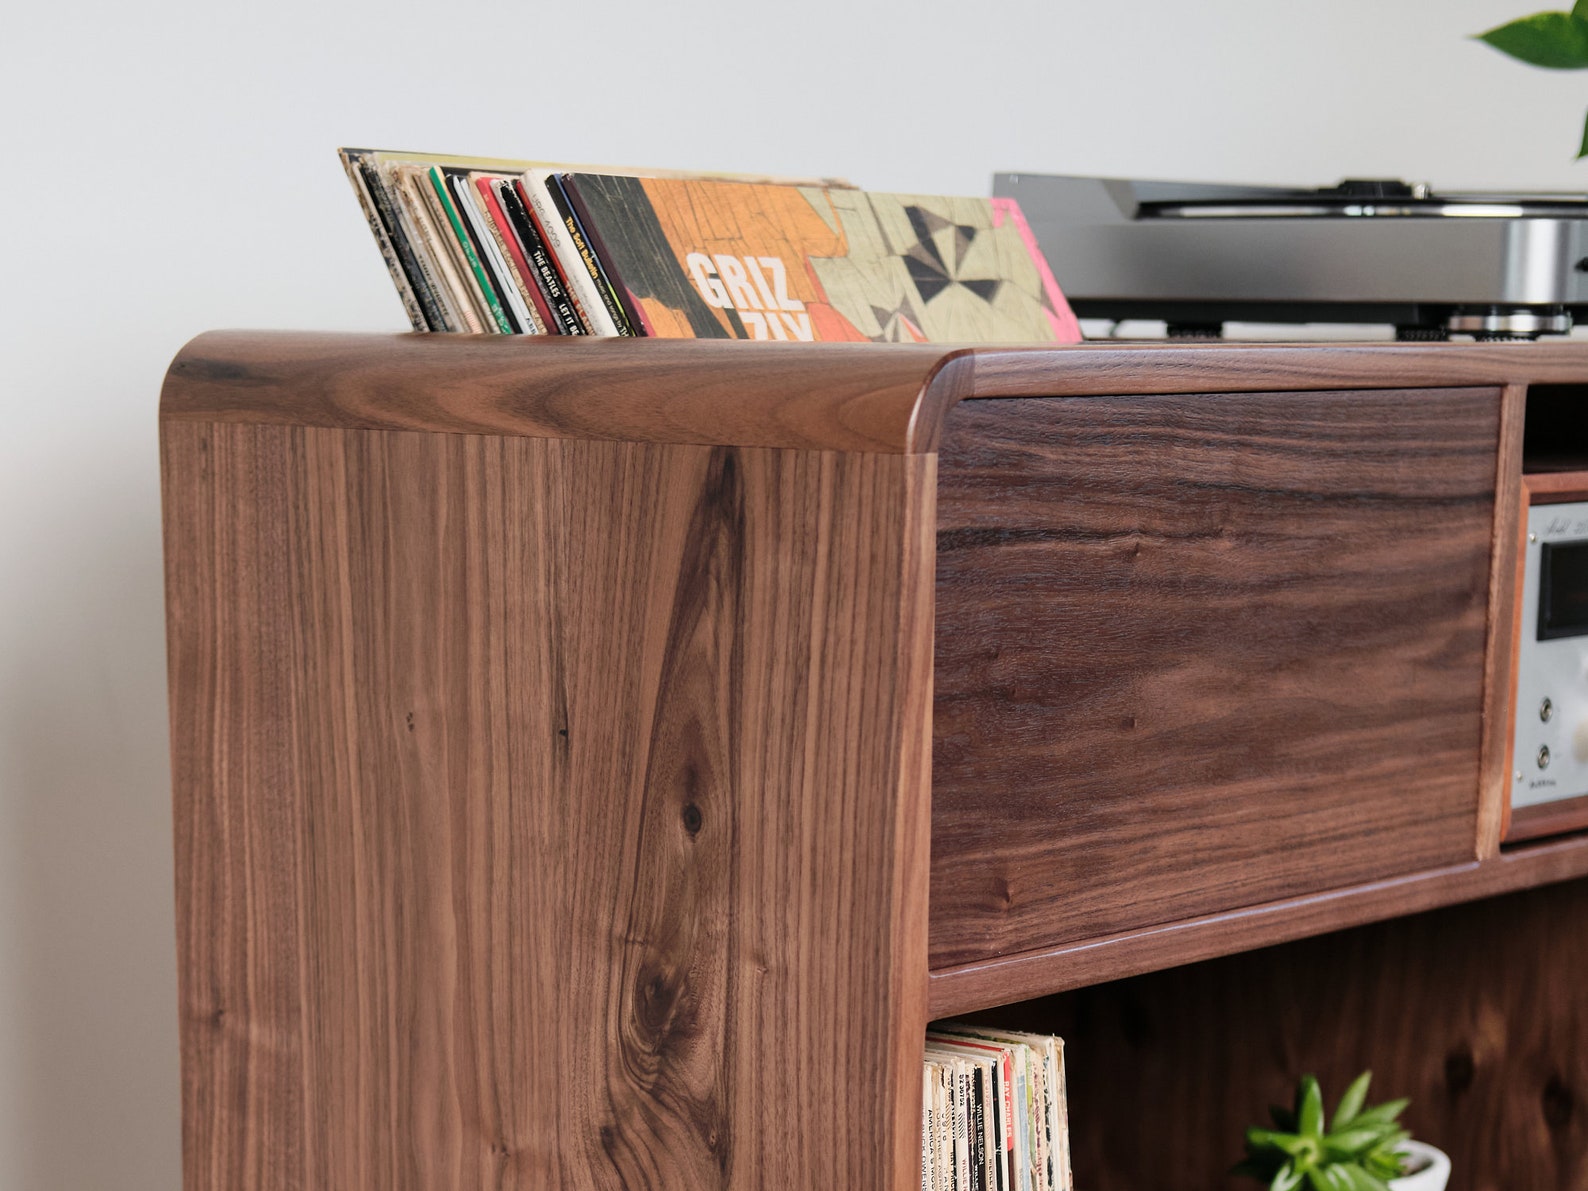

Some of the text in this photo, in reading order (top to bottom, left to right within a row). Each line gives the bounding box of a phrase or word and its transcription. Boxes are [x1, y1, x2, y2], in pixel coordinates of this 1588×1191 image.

[566, 217, 576, 234] The
[573, 233, 585, 251] Soft
[581, 249, 599, 280] Bulletin
[533, 251, 545, 268] THE
[541, 264, 561, 298] BEATLES
[559, 303, 568, 318] LET
[565, 314, 574, 326] IT
[686, 252, 806, 312] GRIZ
[1003, 1080, 1012, 1138] RAY CHARLES
[977, 1132, 985, 1166] NELSON
